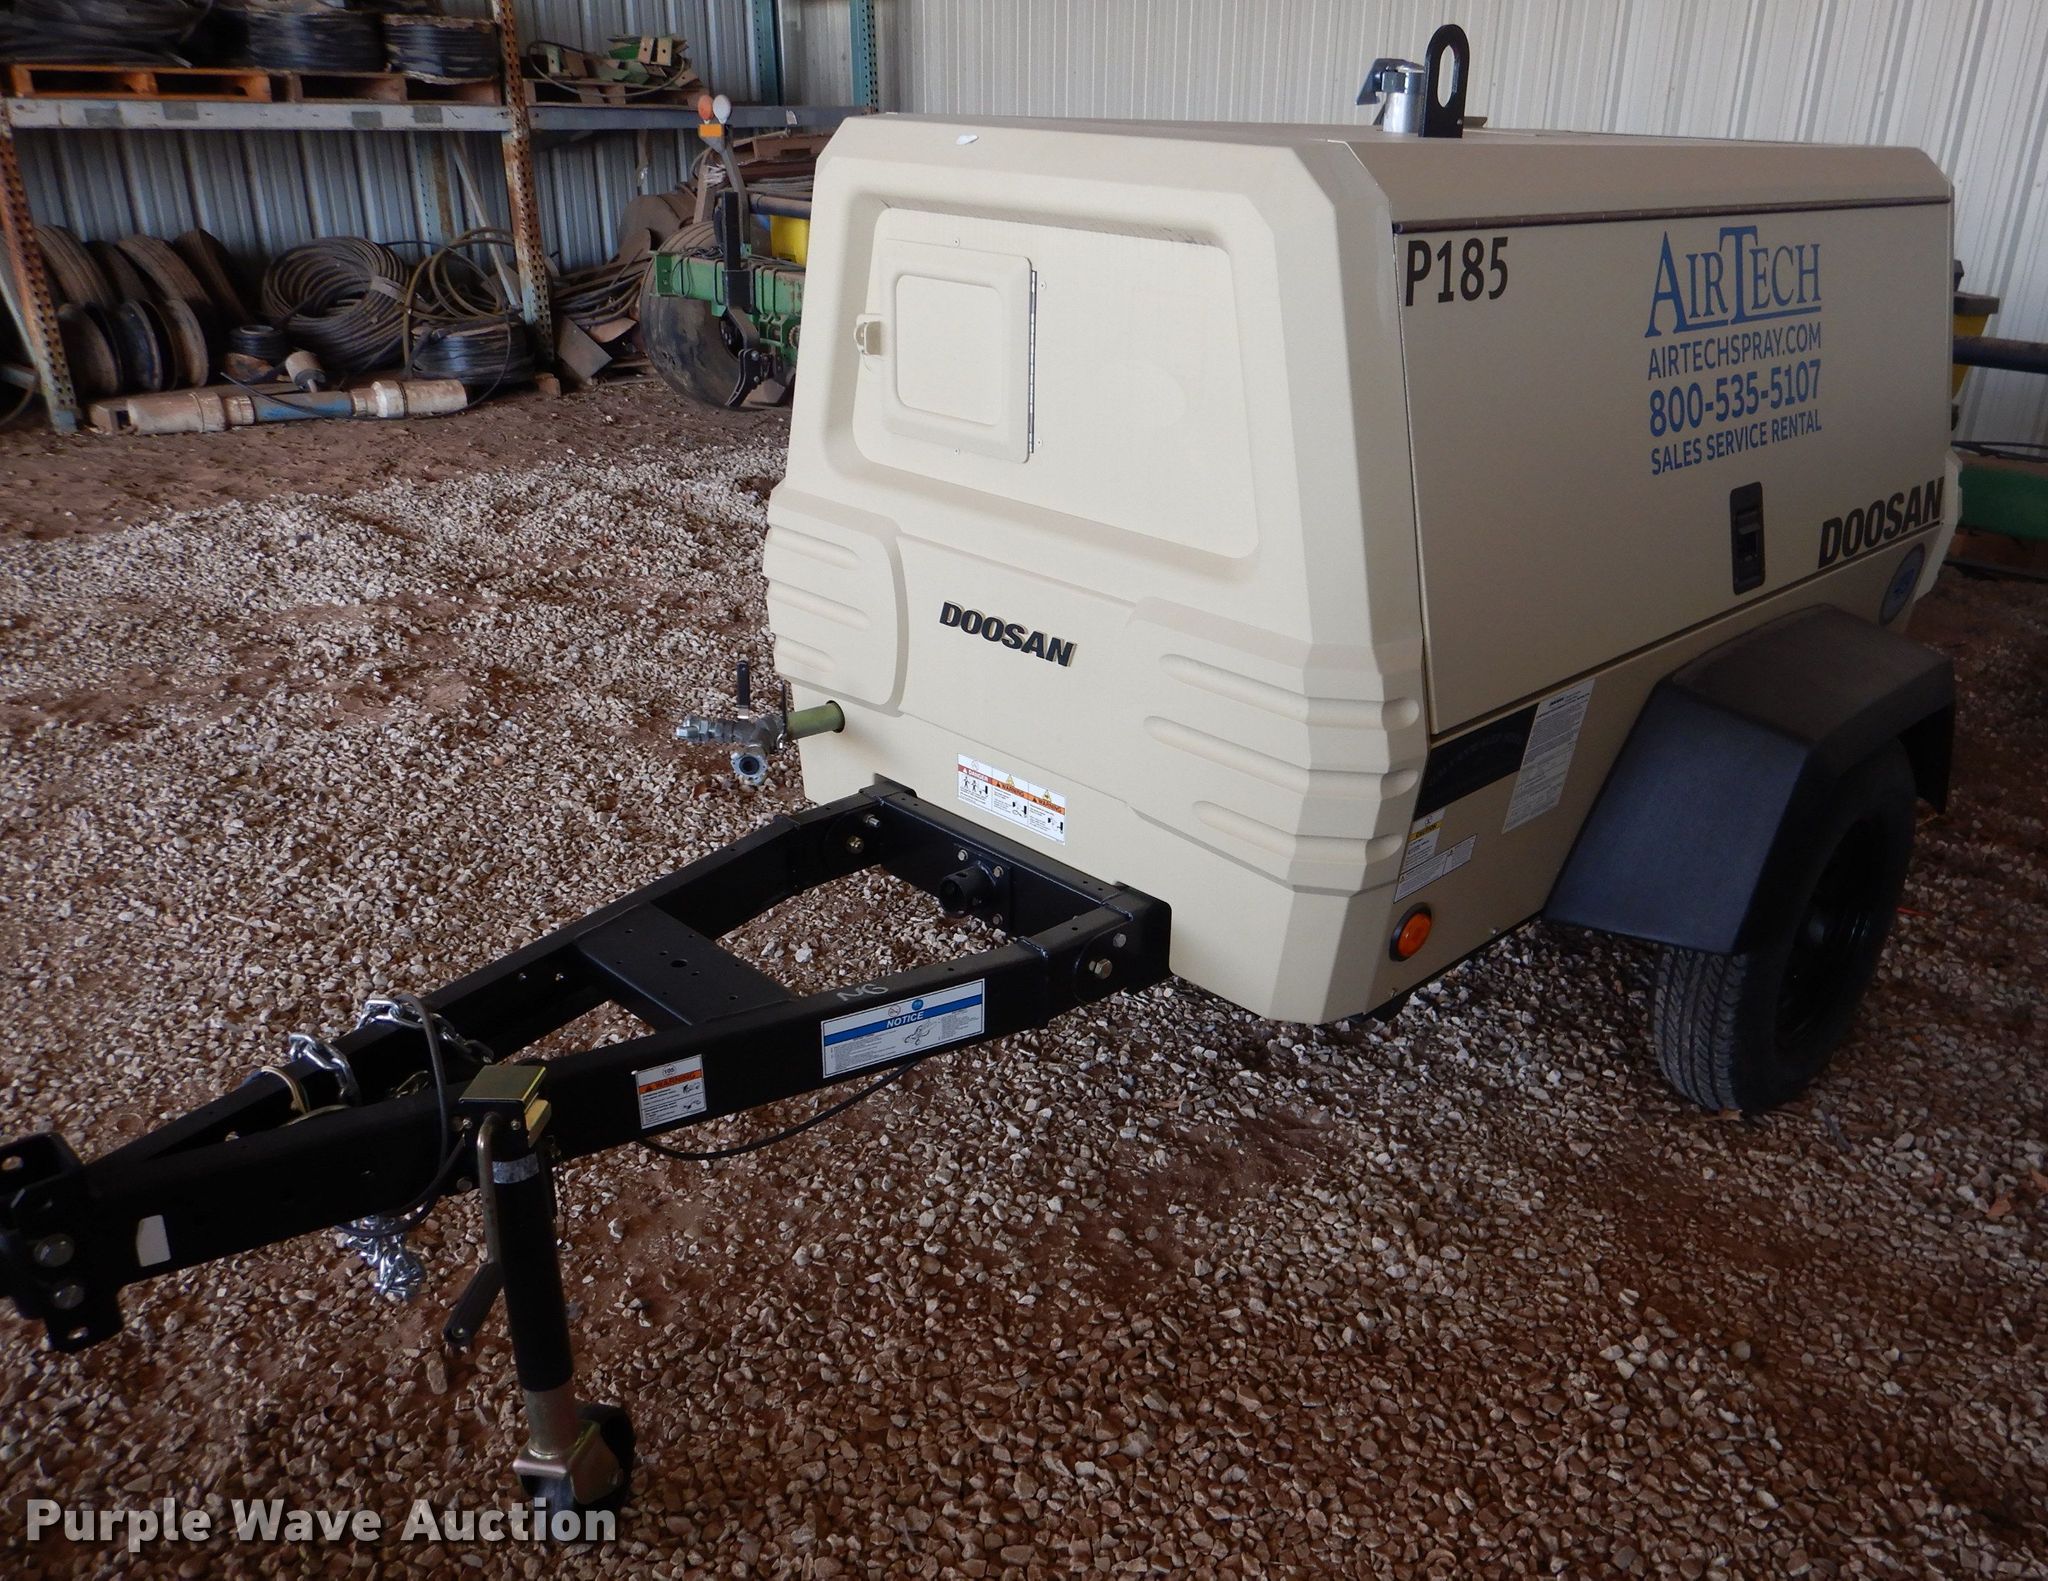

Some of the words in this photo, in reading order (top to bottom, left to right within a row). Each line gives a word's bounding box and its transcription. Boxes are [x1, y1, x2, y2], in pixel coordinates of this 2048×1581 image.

[1405, 236, 1509, 307] P185
[1648, 322, 1821, 381] AIRTECHSPRAY.COM
[1650, 358, 1822, 437] 800-535-5107
[1651, 438, 1703, 476] SALES
[1706, 421, 1767, 461] SERVICE
[1771, 409, 1822, 443] RENTAL
[1818, 476, 1945, 569] DOOSAN
[939, 601, 1076, 667] DOOSAN
[886, 1011, 925, 1029] NOTICE
